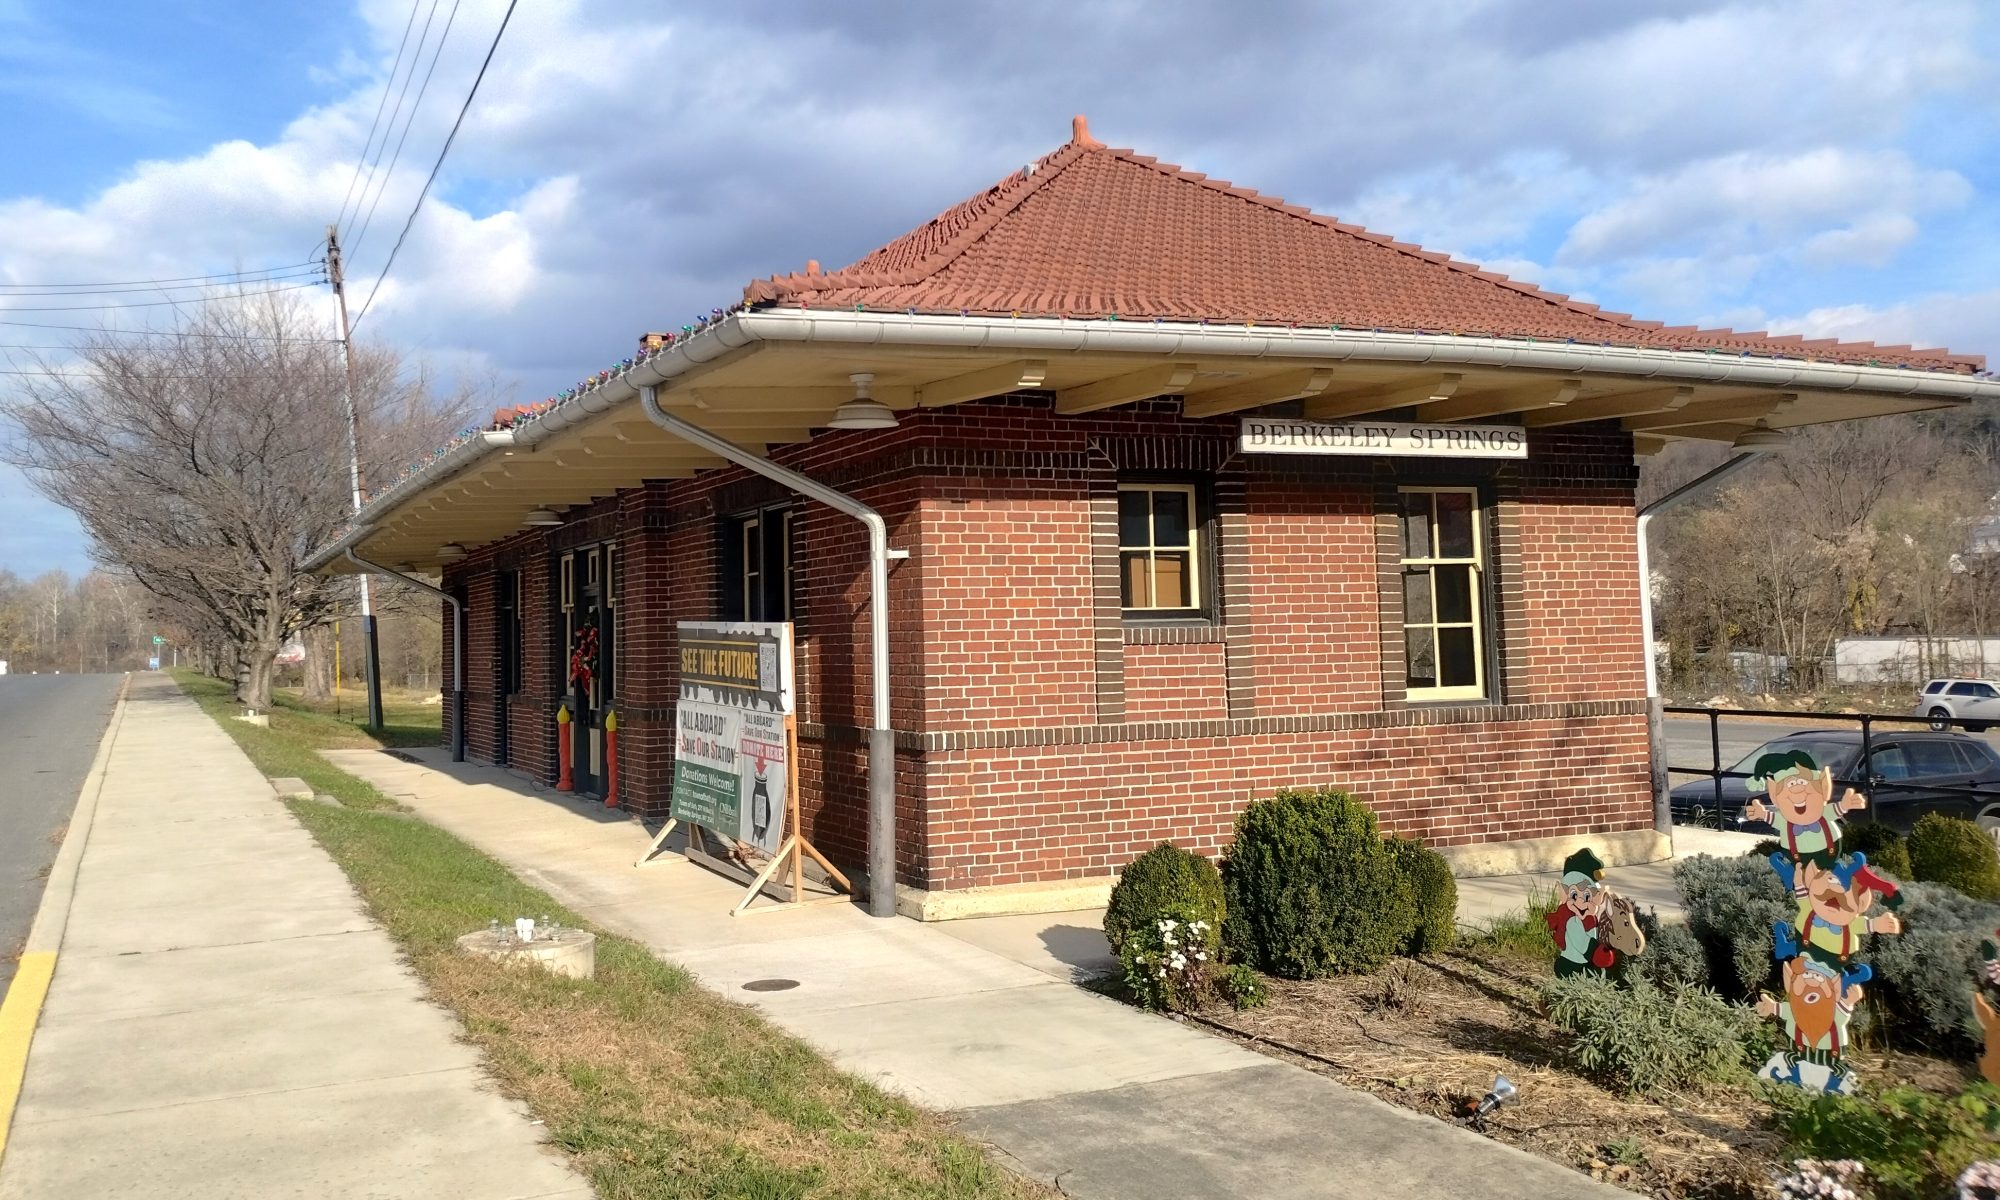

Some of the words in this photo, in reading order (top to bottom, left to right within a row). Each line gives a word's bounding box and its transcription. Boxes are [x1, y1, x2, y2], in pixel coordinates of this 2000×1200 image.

[1250, 423, 1396, 448] BERKELEY
[1409, 428, 1521, 451] SPRINGS
[681, 648, 698, 673] SEE
[699, 649, 717, 675] THE
[719, 650, 758, 680] FUTURE
[694, 712, 727, 736] ABOARD"
[682, 734, 696, 755] SAVE
[697, 737, 710, 758] OUR
[711, 740, 735, 764] STATION
[681, 766, 708, 784] Donations
[709, 773, 735, 792] Welcome!
